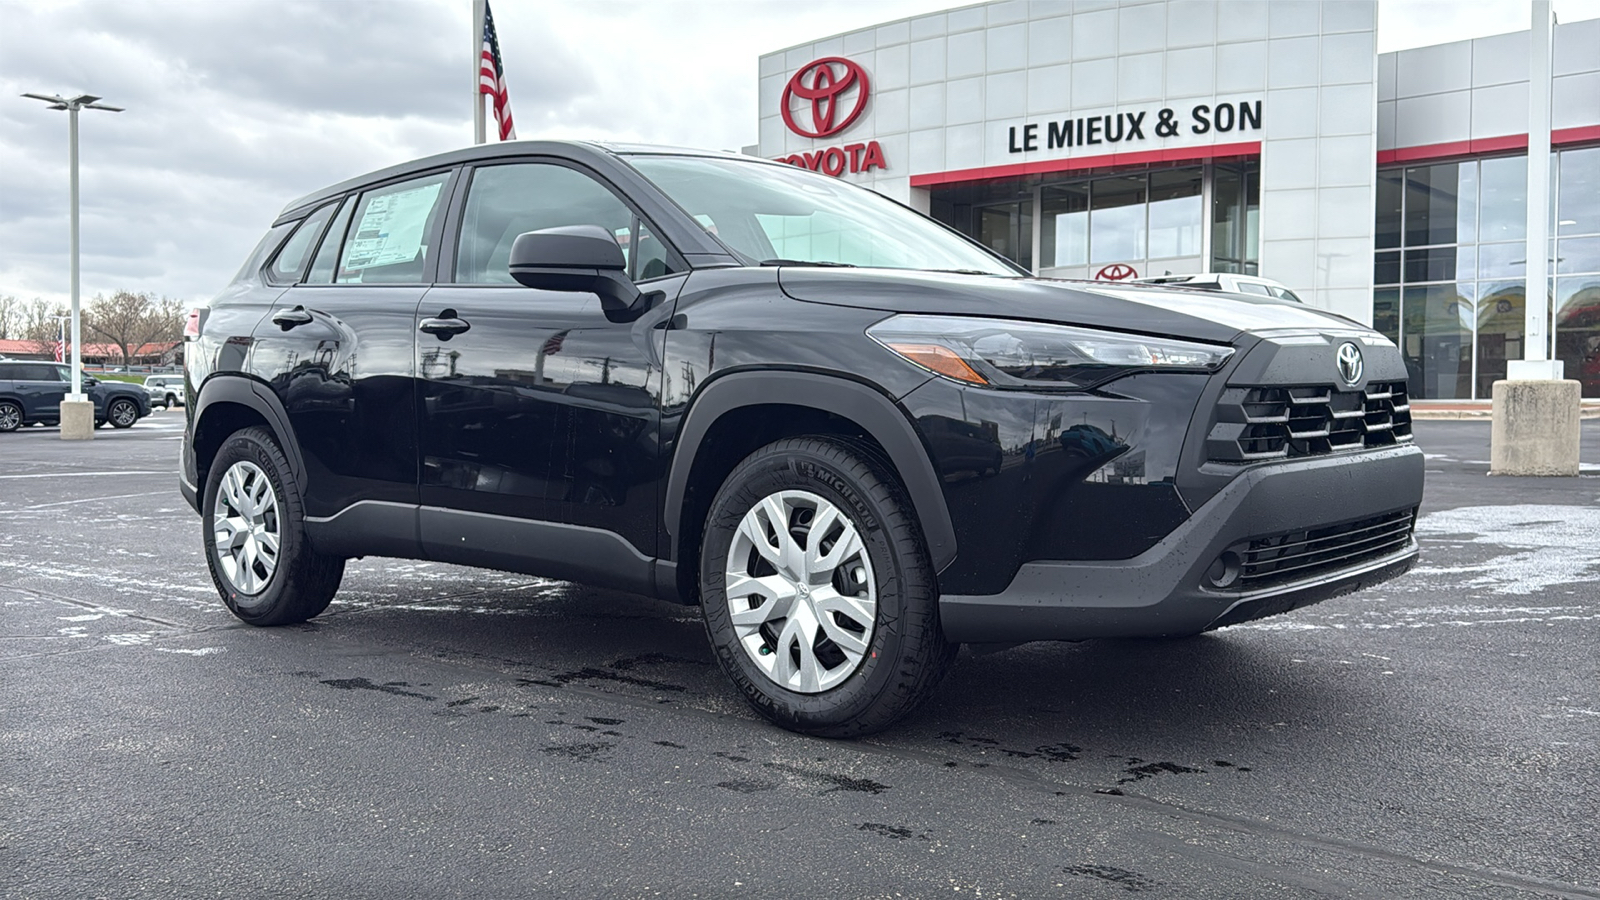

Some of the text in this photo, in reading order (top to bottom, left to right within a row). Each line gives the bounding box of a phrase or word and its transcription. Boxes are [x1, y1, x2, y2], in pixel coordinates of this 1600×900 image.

[1009, 100, 1261, 153] LE MIEUX & SON
[774, 141, 886, 176] YOTA
[817, 469, 876, 528] MICHELIN
